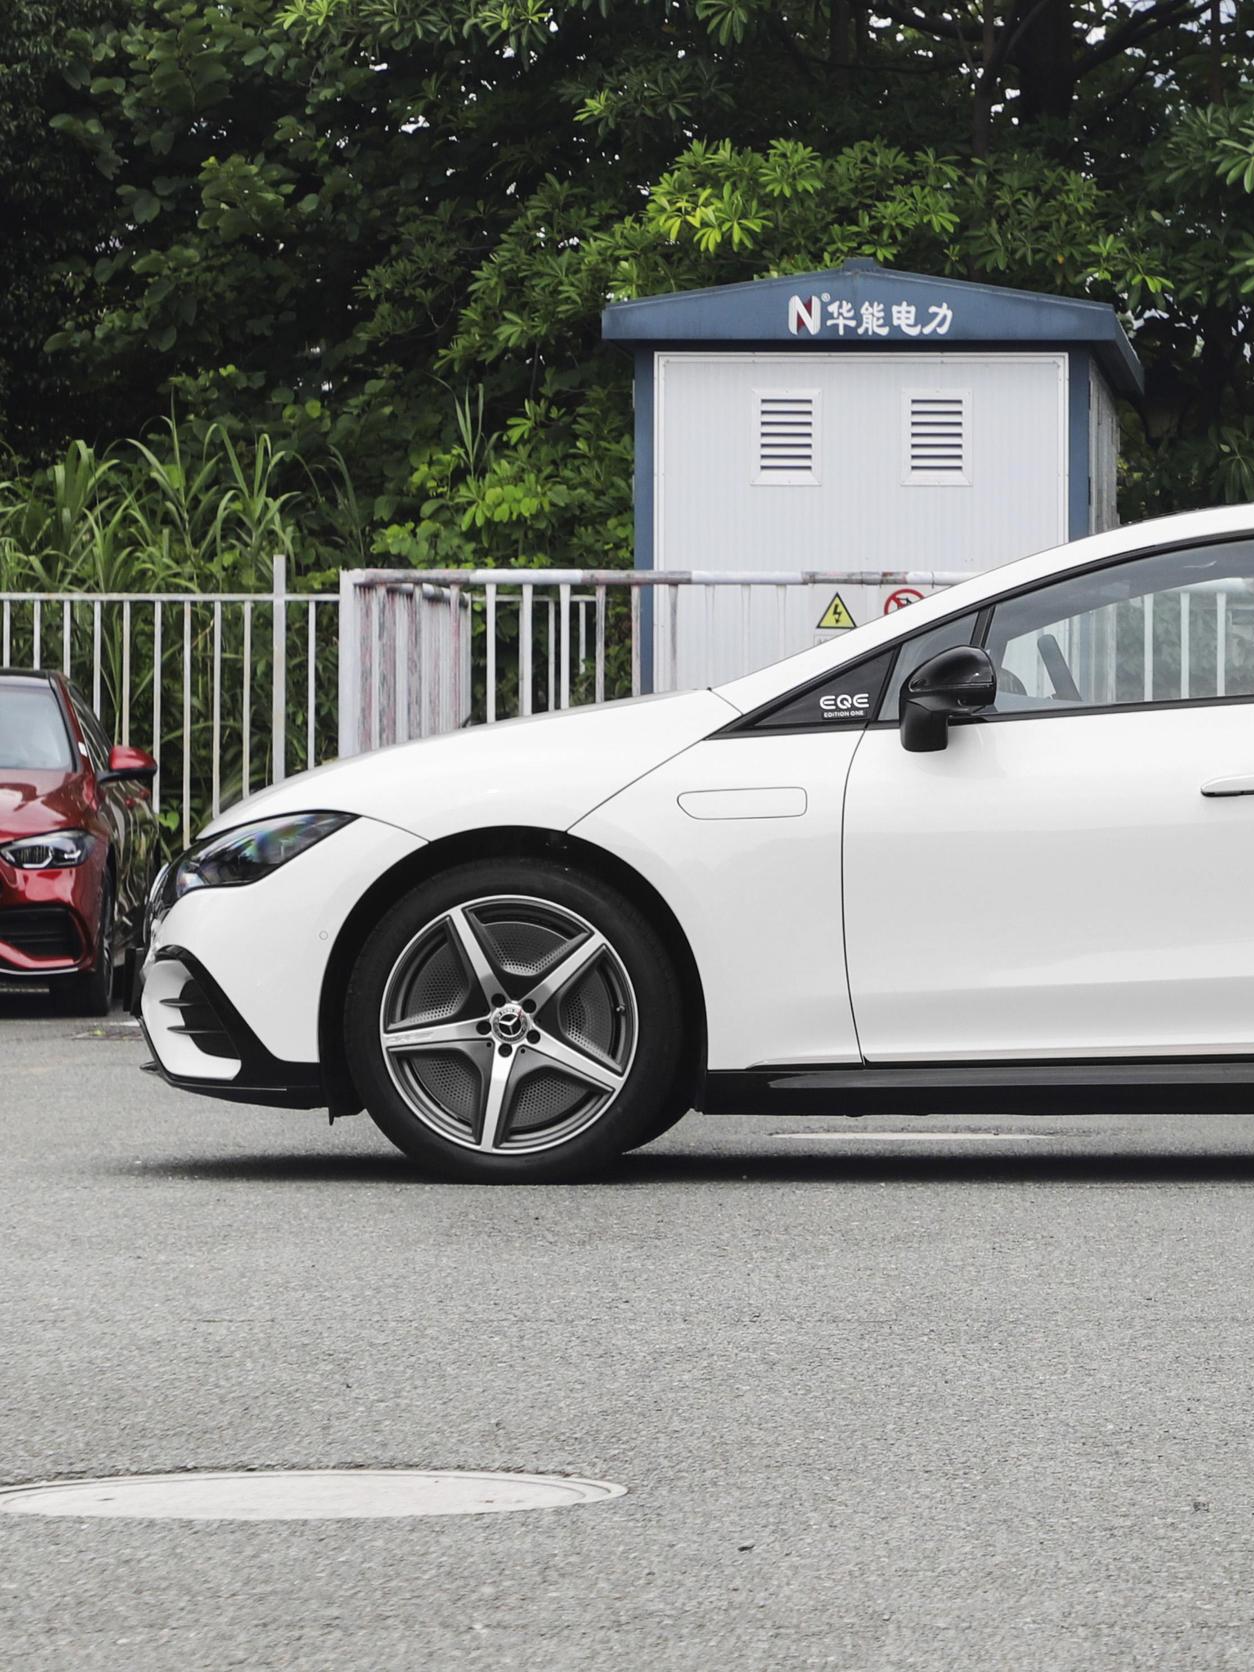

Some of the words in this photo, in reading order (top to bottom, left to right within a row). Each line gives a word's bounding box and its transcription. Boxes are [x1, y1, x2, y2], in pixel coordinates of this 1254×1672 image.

[826, 300, 953, 336] 华能电力
[820, 693, 869, 709] EQE
